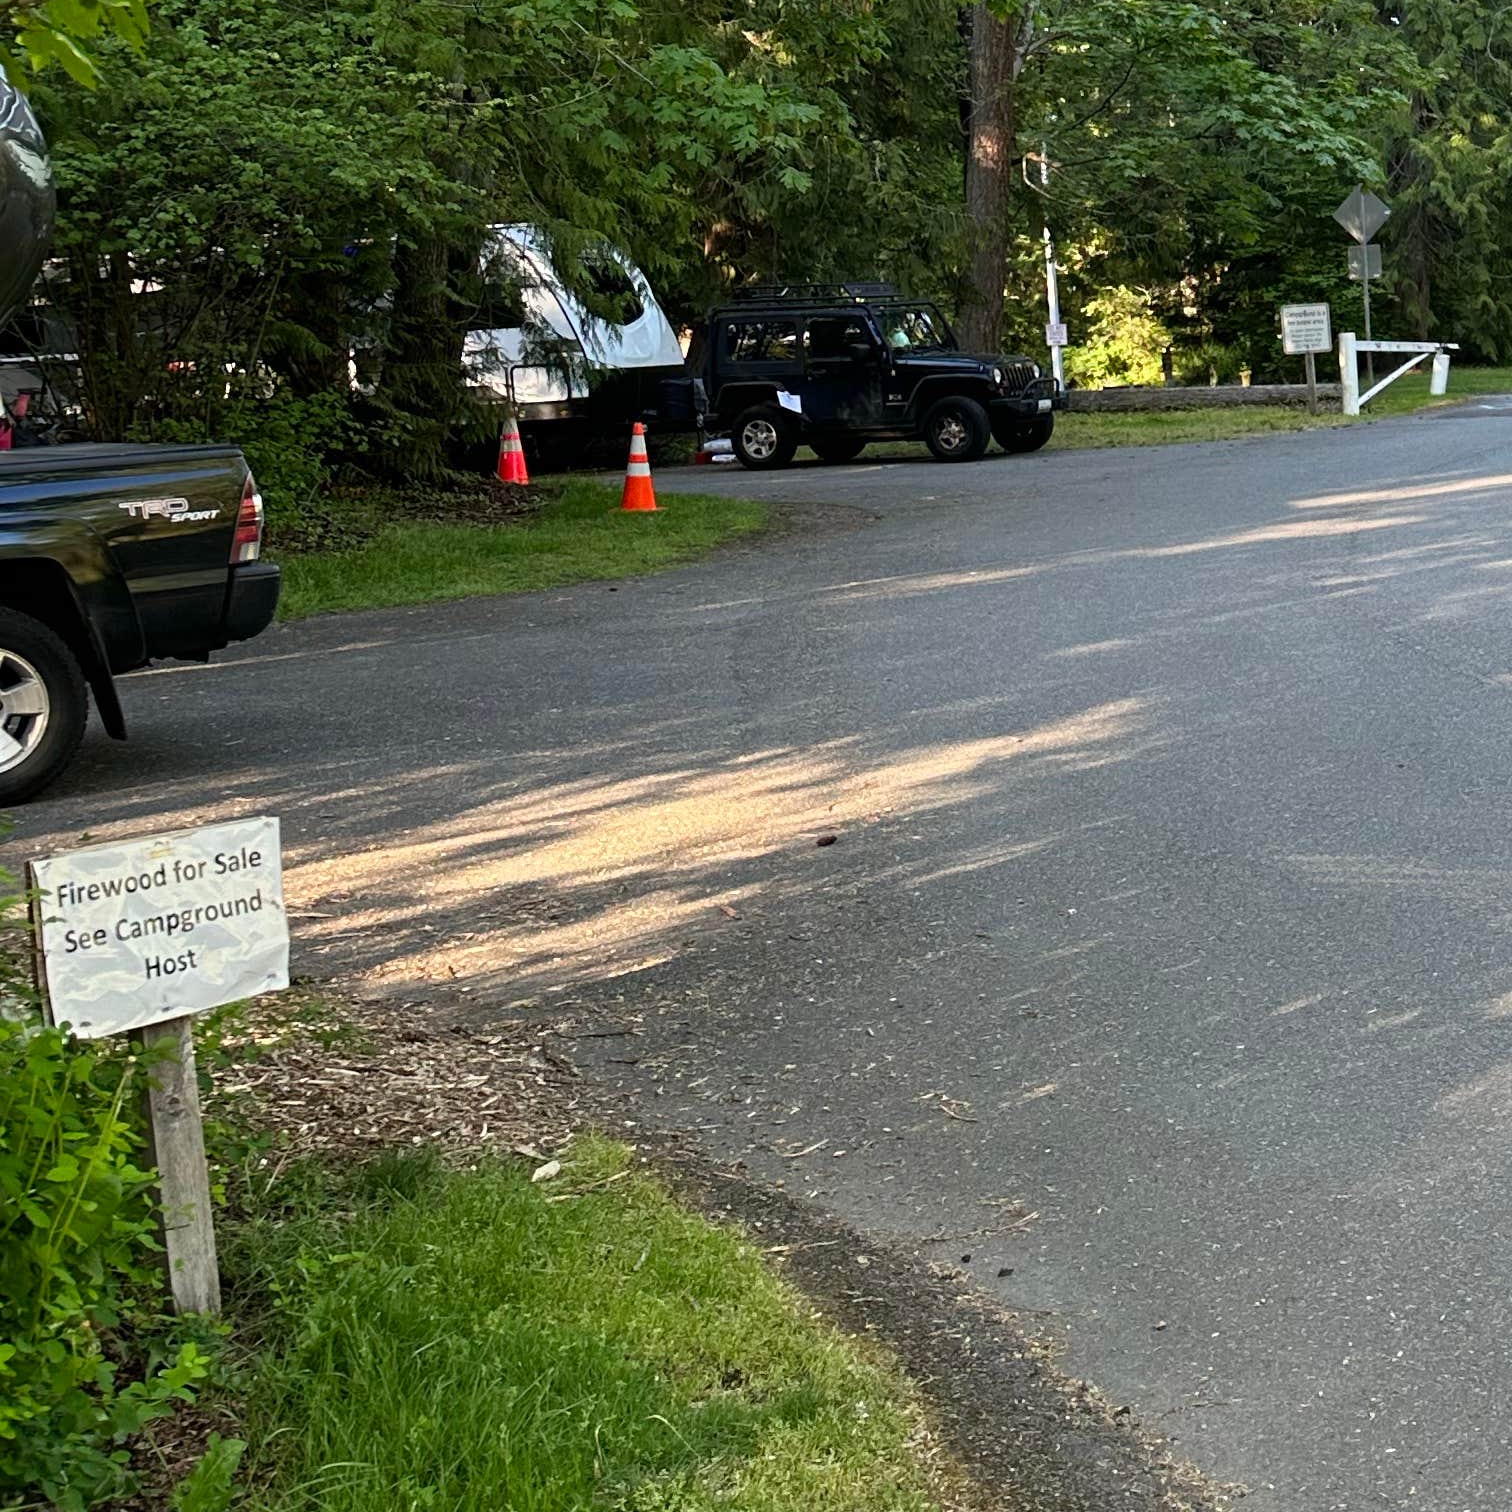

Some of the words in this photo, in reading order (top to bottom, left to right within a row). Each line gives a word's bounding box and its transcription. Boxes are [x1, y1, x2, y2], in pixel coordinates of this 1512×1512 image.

[119, 497, 189, 520] TRD
[170, 509, 221, 523] SPORT
[56, 863, 166, 908] Firewood
[172, 859, 207, 885] for
[214, 847, 261, 875] Sale
[64, 928, 107, 954] See
[115, 888, 263, 942] Campground
[145, 948, 198, 980] Host
